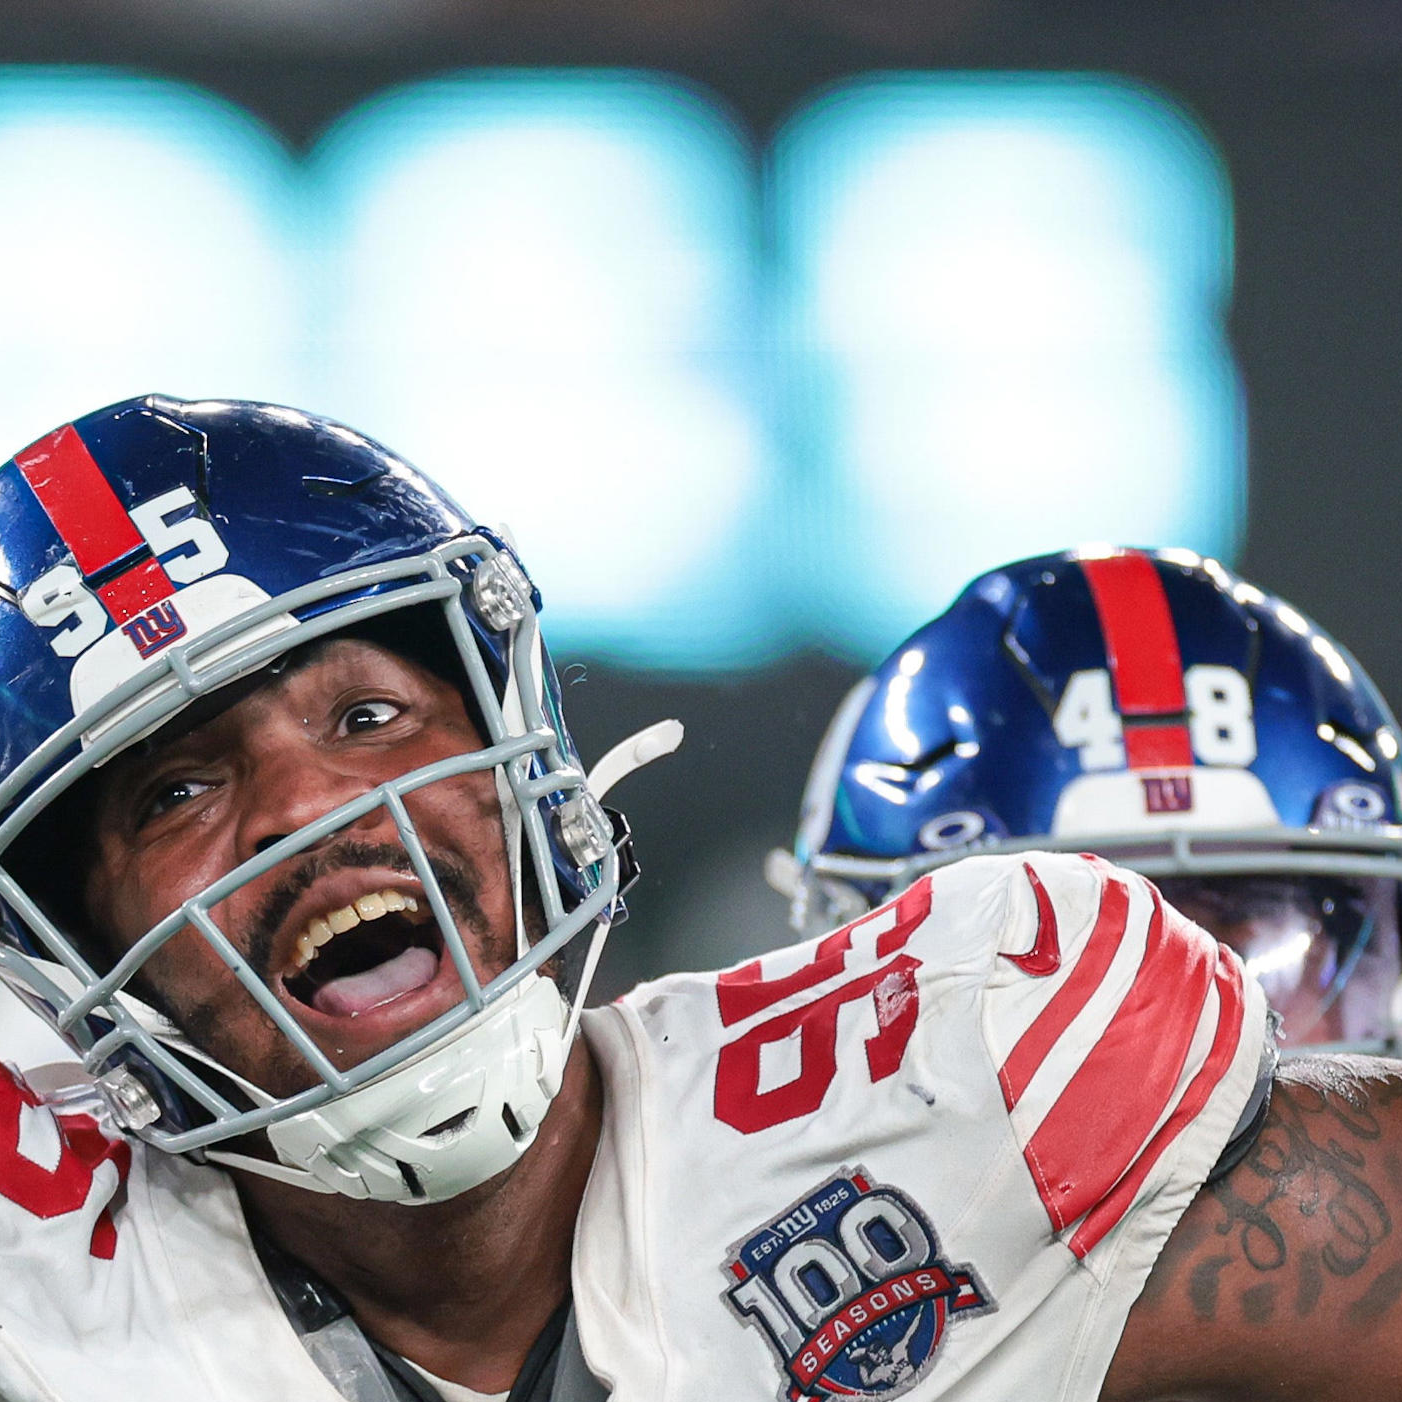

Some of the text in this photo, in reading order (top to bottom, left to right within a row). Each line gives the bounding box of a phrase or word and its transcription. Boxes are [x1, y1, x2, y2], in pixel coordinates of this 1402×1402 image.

[18, 485, 230, 658] 95
[1052, 662, 1258, 770] 48
[813, 1188, 849, 1216] 1925
[729, 1190, 936, 1357] 100
[802, 1273, 936, 1373] SEASONS
